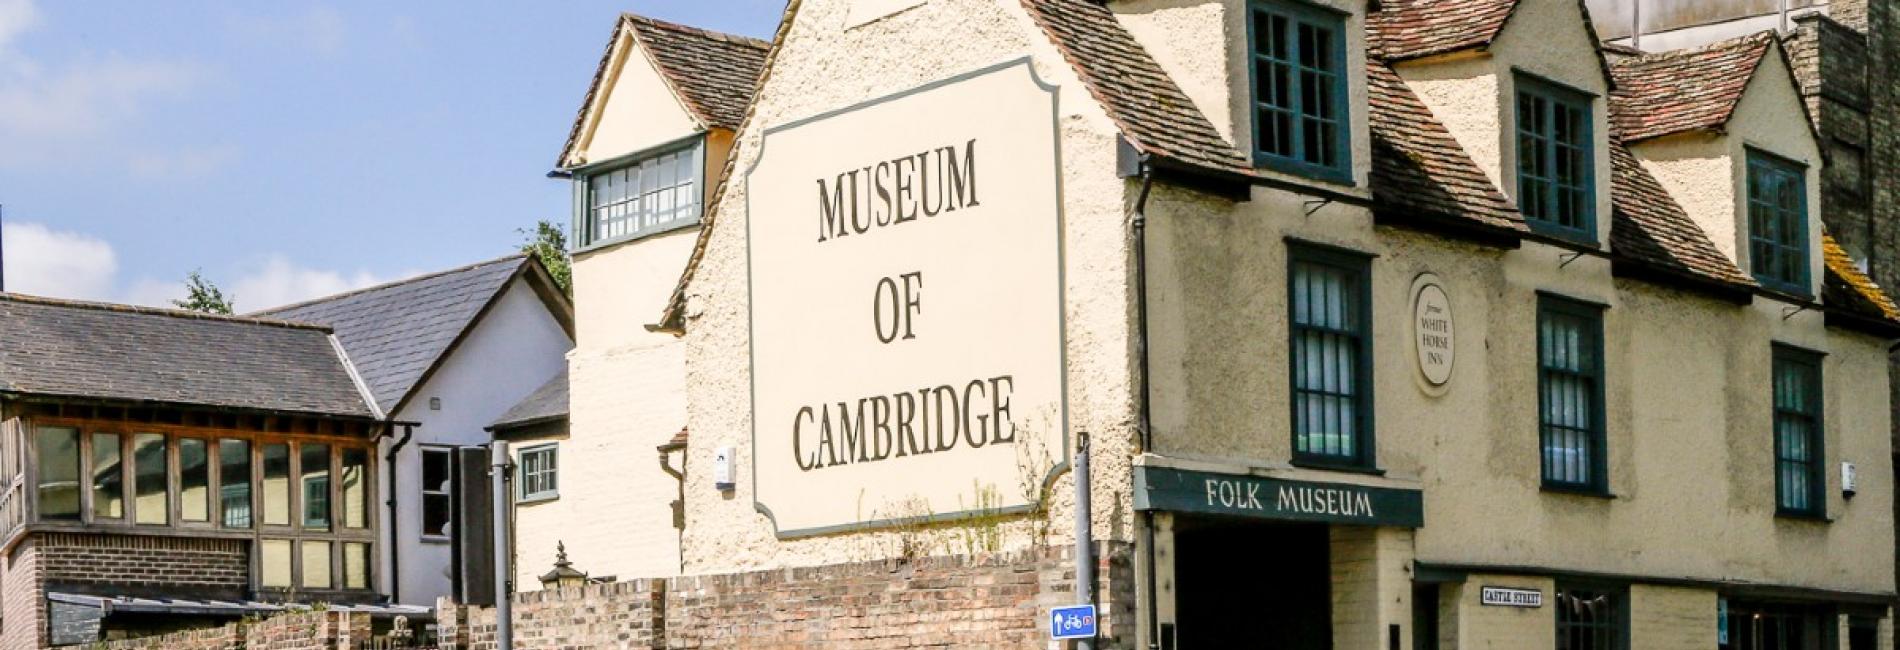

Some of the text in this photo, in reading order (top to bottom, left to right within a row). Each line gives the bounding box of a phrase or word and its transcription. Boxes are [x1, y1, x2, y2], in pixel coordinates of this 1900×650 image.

[817, 138, 980, 243] MUSEUM
[873, 271, 923, 344] OF
[1421, 317, 1448, 333] WHITE
[1422, 333, 1448, 349] HORSE
[1427, 352, 1443, 366] INN
[793, 374, 1016, 471] CAMBRIDGE
[1205, 479, 1374, 517] FOLK MUSEUM
